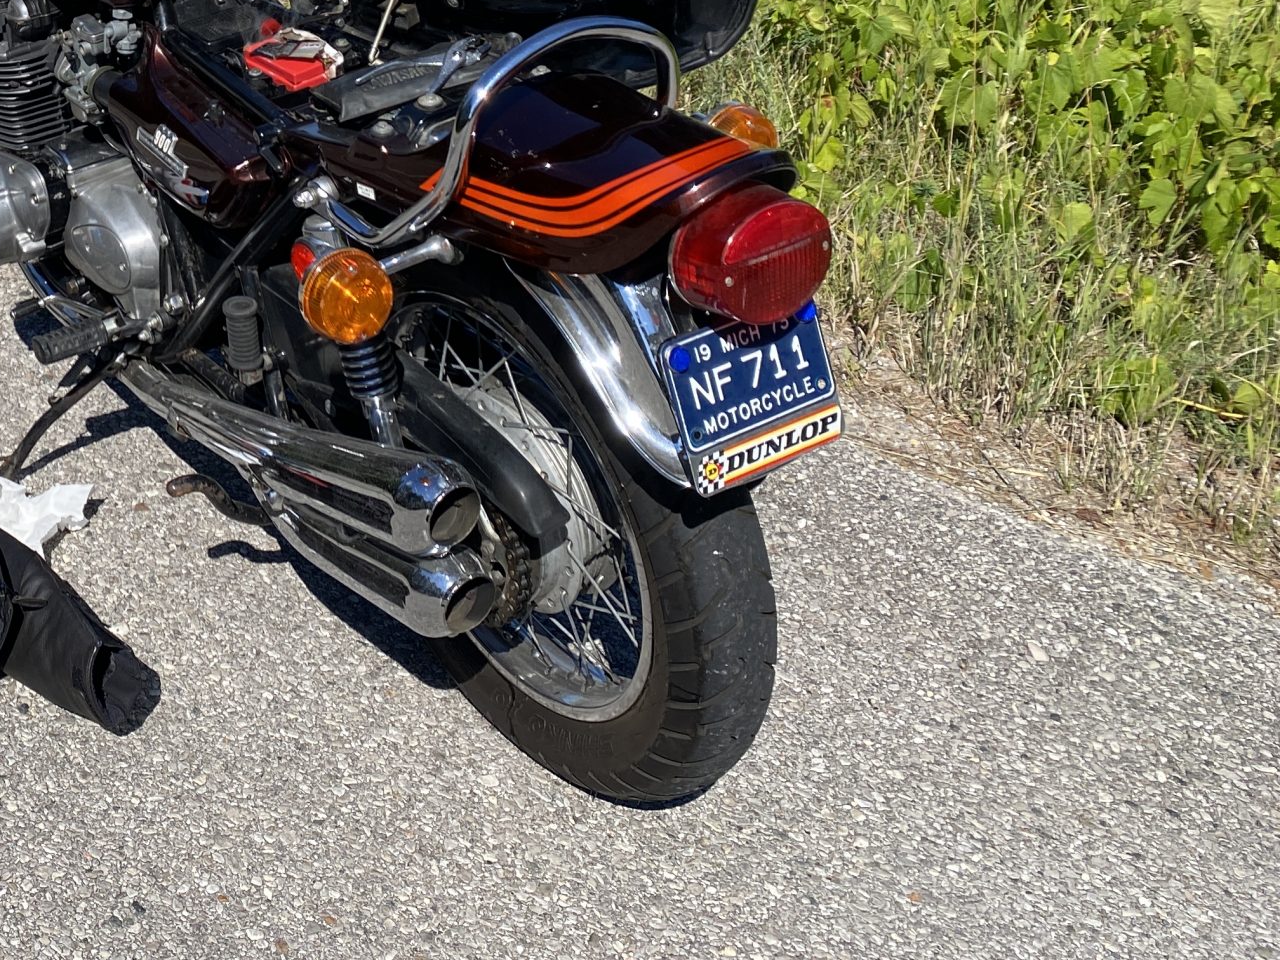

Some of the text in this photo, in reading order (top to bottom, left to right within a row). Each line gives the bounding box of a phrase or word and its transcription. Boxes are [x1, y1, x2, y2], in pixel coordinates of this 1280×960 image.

[153, 129, 172, 153] 900
[688, 334, 810, 411] NF 711
[694, 343, 712, 364] 19
[720, 324, 761, 354] MICH
[703, 375, 816, 436] MOTORCYCLE
[725, 412, 838, 475] DUNLOP
